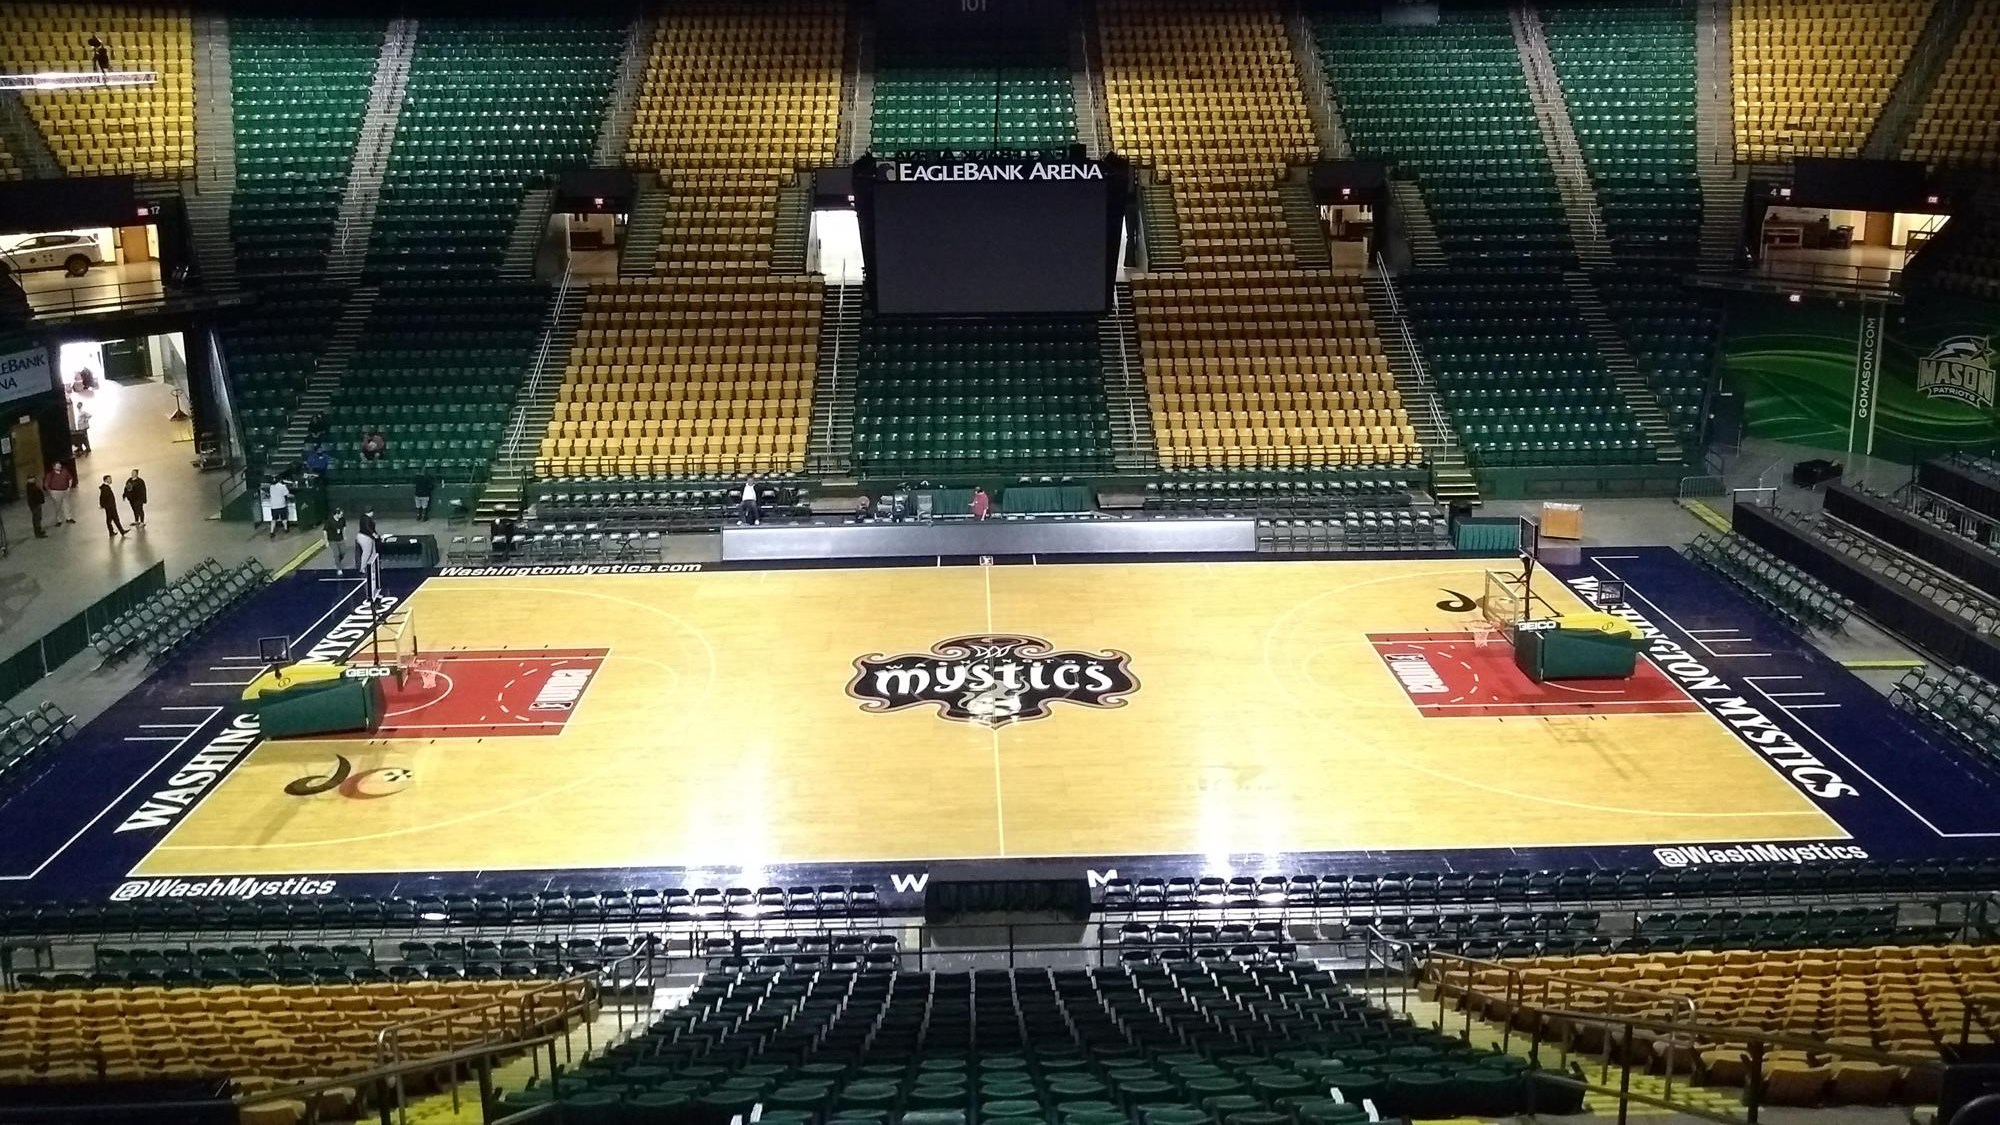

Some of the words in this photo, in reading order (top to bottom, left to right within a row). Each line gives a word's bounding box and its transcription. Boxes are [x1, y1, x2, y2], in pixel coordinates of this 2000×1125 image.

[1029, 161, 1104, 180] ARENA
[0, 355, 45, 375] EBANK
[1858, 317, 1877, 419] GOMASON.COM
[1919, 361, 1992, 402] MASON
[1933, 387, 1976, 401] PATRIOTS
[437, 562, 703, 577] WashingtonMystics.com
[346, 668, 391, 678] GEICO
[1703, 696, 1859, 798] MYSTICS
[1652, 843, 1870, 868] @WashMystics
[109, 877, 336, 902] @WashMystics
